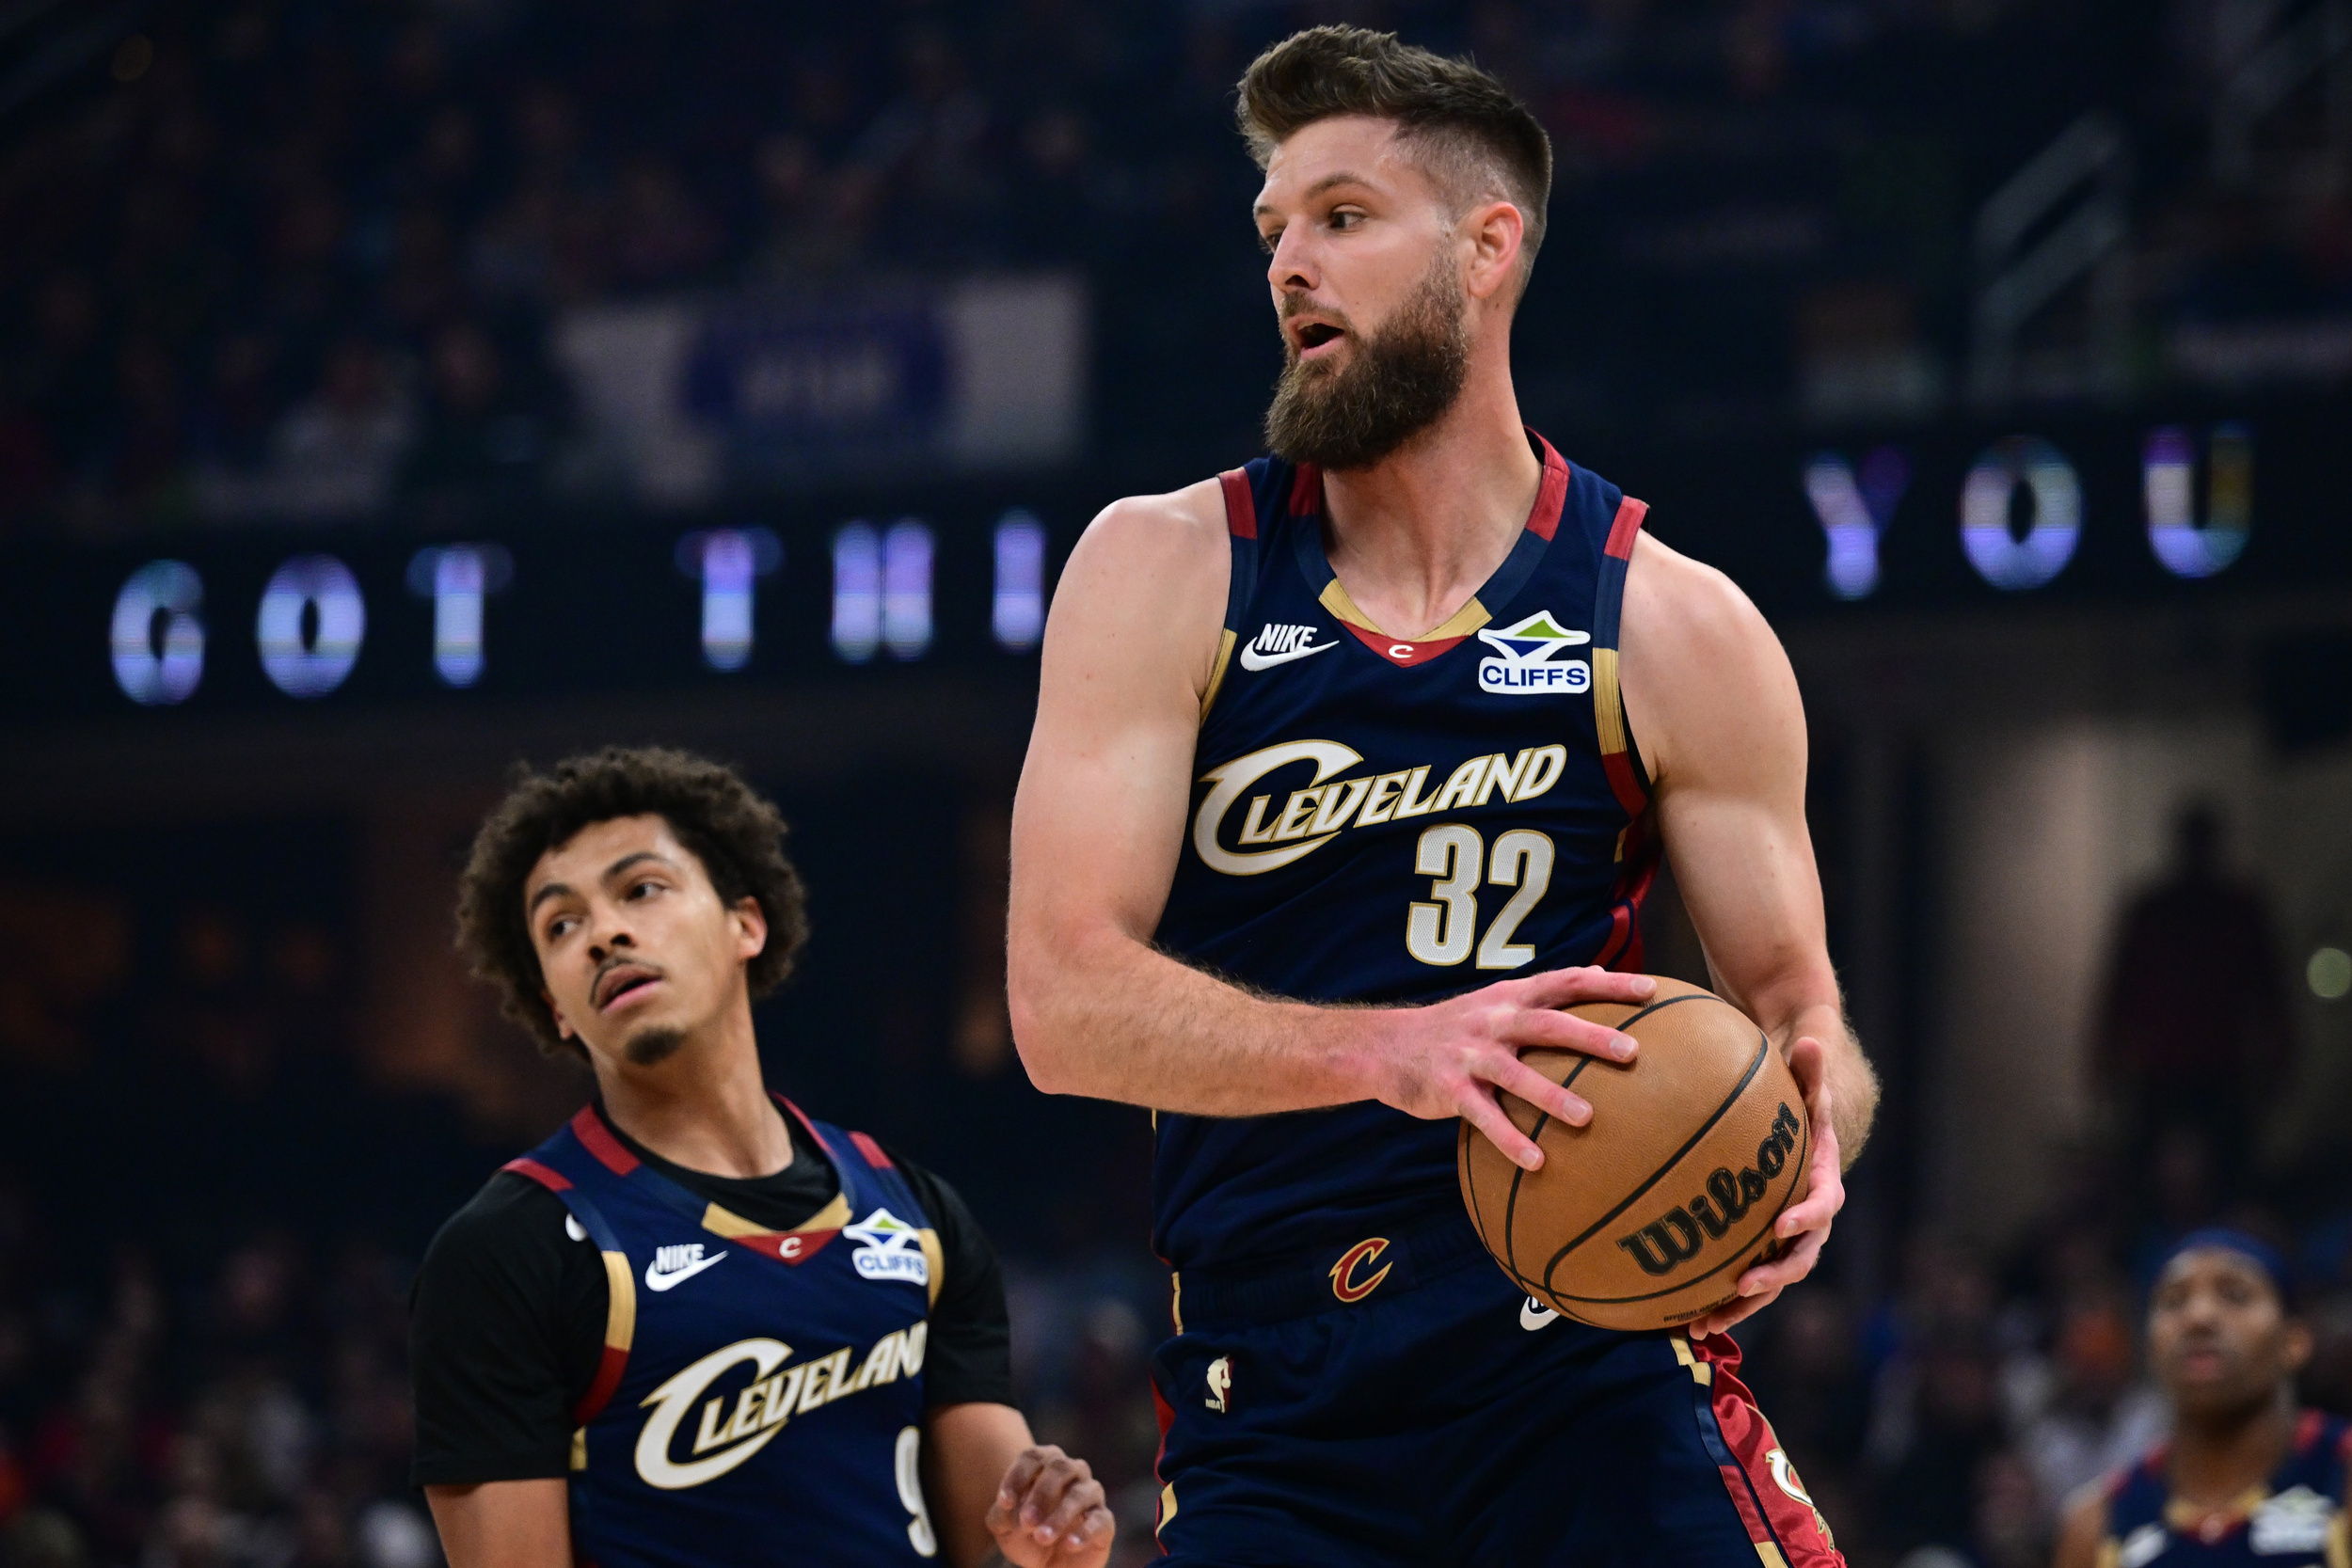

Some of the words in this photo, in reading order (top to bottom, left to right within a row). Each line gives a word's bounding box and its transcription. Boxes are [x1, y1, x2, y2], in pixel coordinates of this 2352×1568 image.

[111, 543, 513, 705] GOT
[675, 510, 1044, 670] THI
[1804, 423, 2255, 600] YOU
[1256, 623, 1317, 653] NIKE
[1482, 665, 1586, 687] CLIFFS
[1194, 738, 1567, 876] CLEVELAND
[1406, 822, 1555, 970] 32
[1616, 1101, 1801, 1276] Wilson
[657, 1243, 706, 1273] NIKE
[859, 1255, 927, 1276] CLIFFS
[634, 1320, 929, 1490] CLEVELAN
